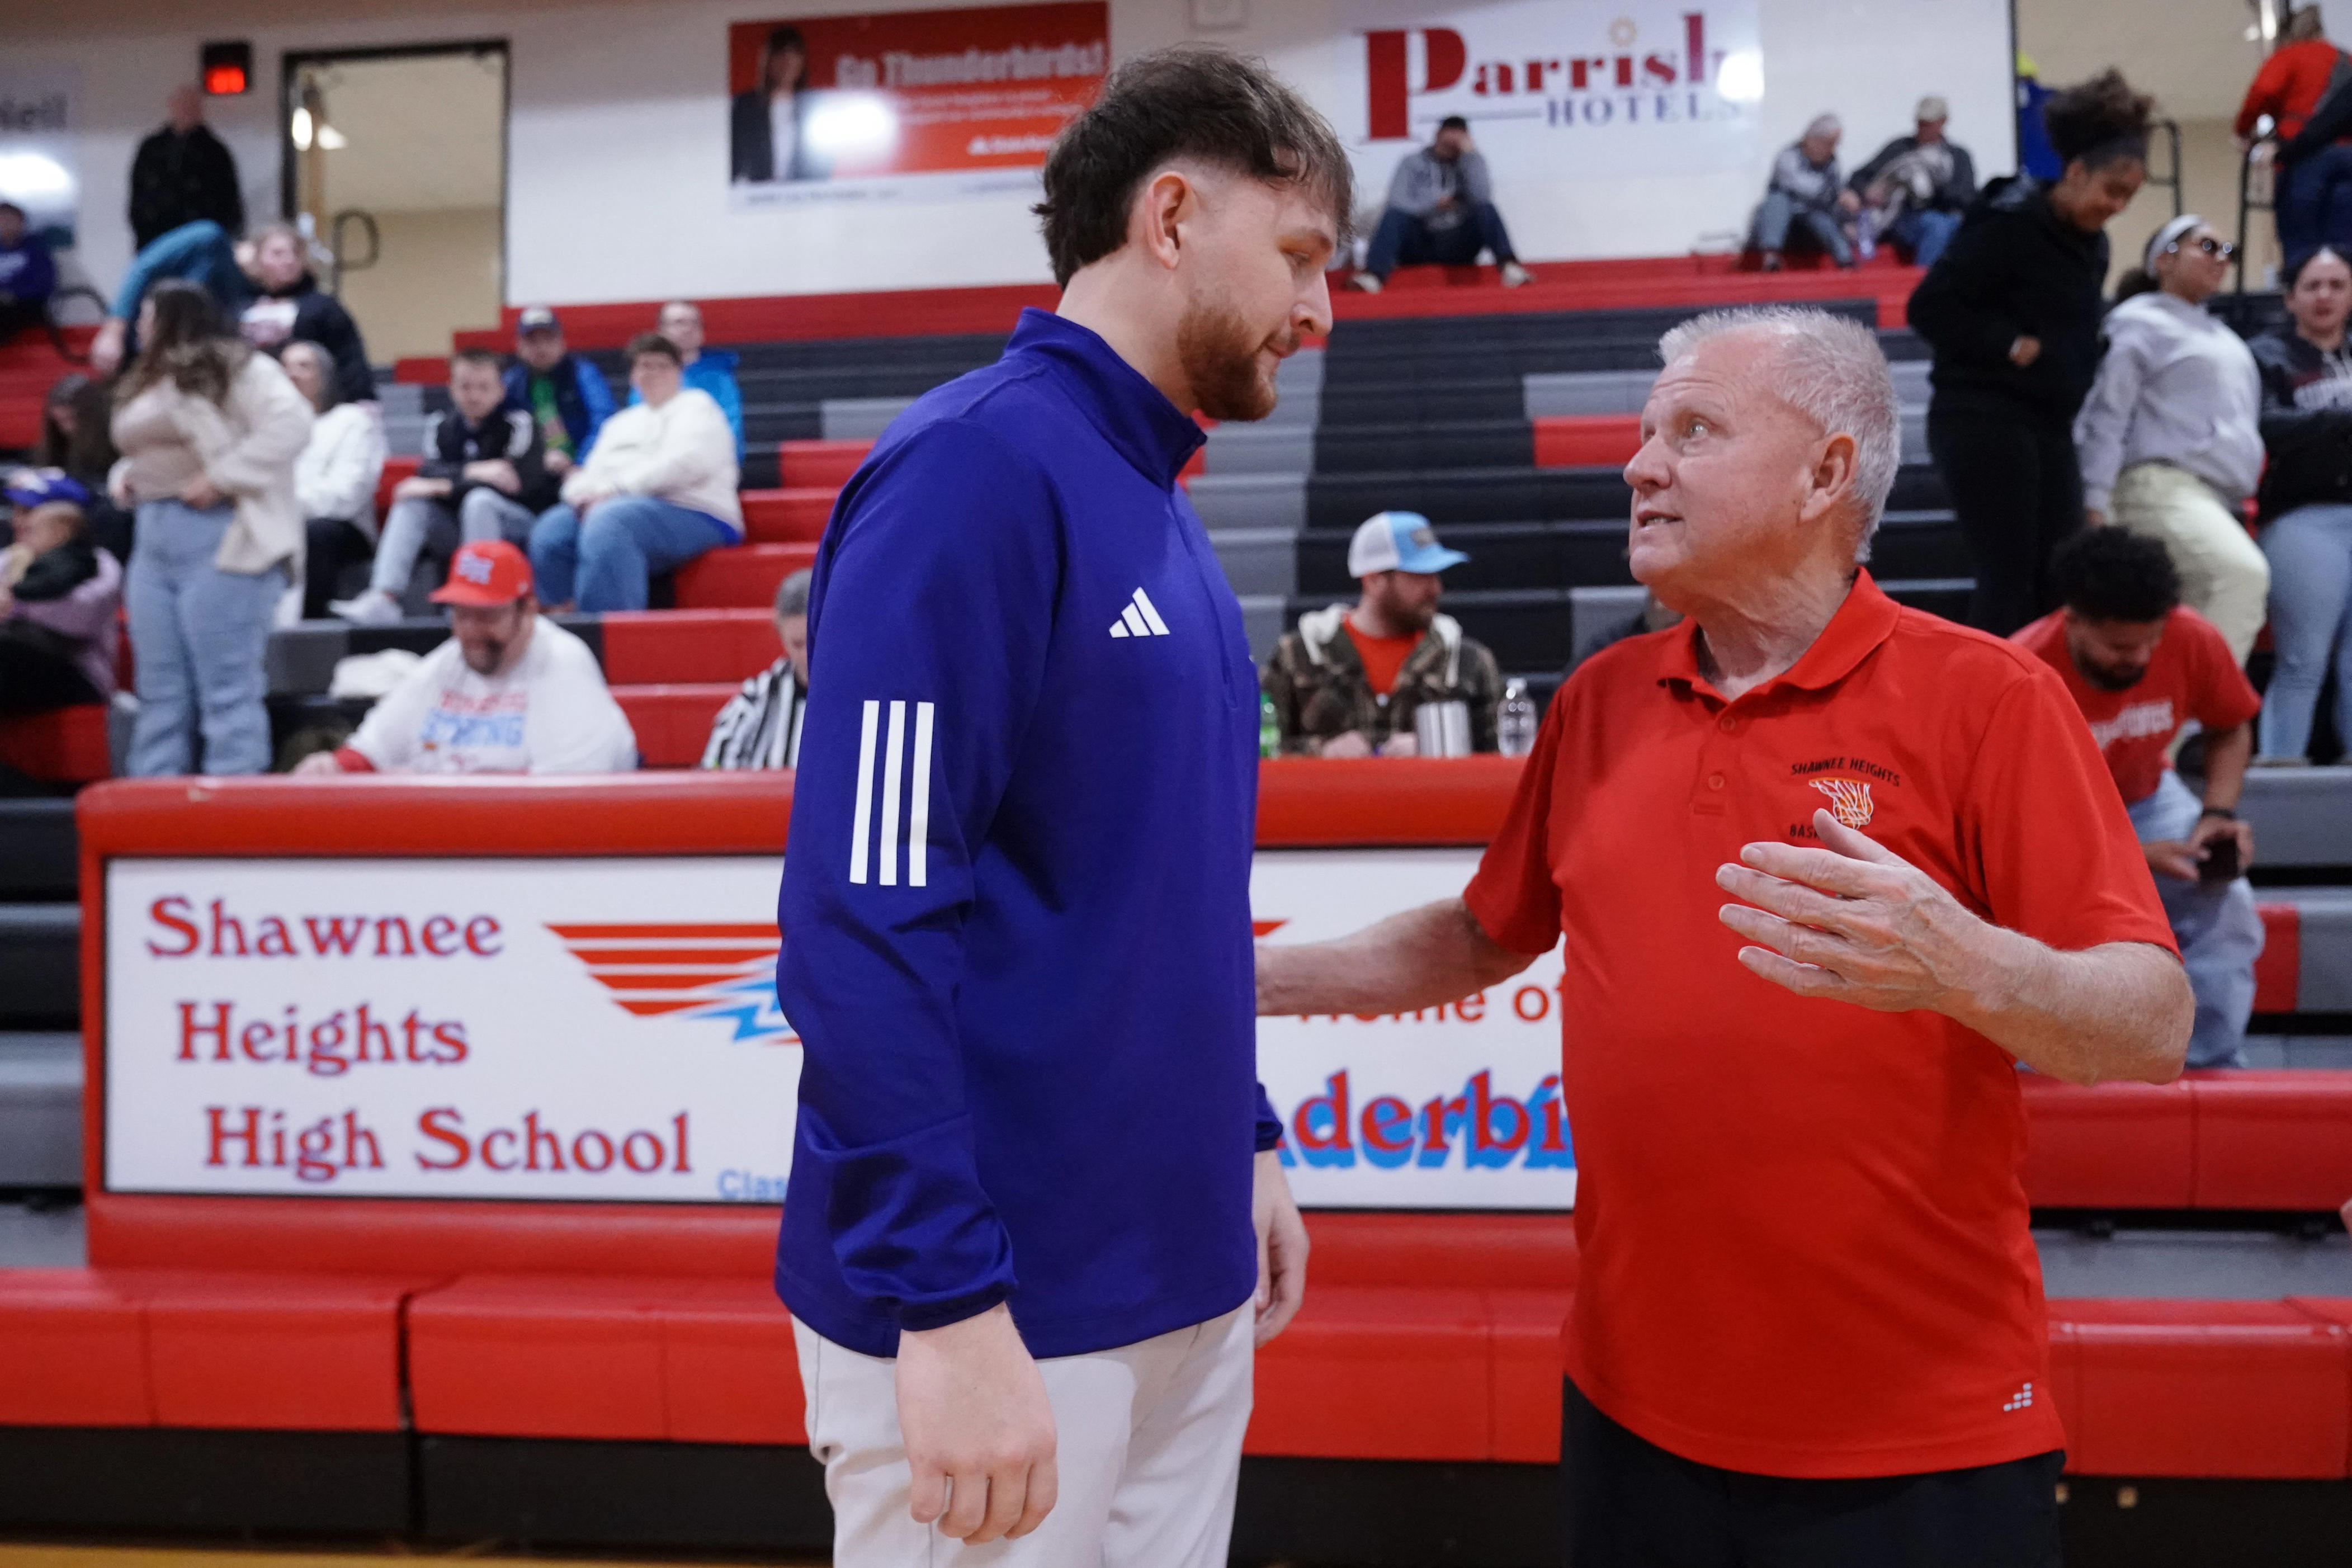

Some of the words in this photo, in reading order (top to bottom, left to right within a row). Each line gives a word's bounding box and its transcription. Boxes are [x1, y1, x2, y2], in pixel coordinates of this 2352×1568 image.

[1791, 757, 1844, 775] SHAWNEE
[1849, 757, 1900, 787] HEIGHTS
[1789, 823, 1819, 839] BAS
[145, 895, 503, 959] Shawnee
[176, 1001, 470, 1075] Heights
[204, 1106, 386, 1181] High
[415, 1107, 693, 1173] School
